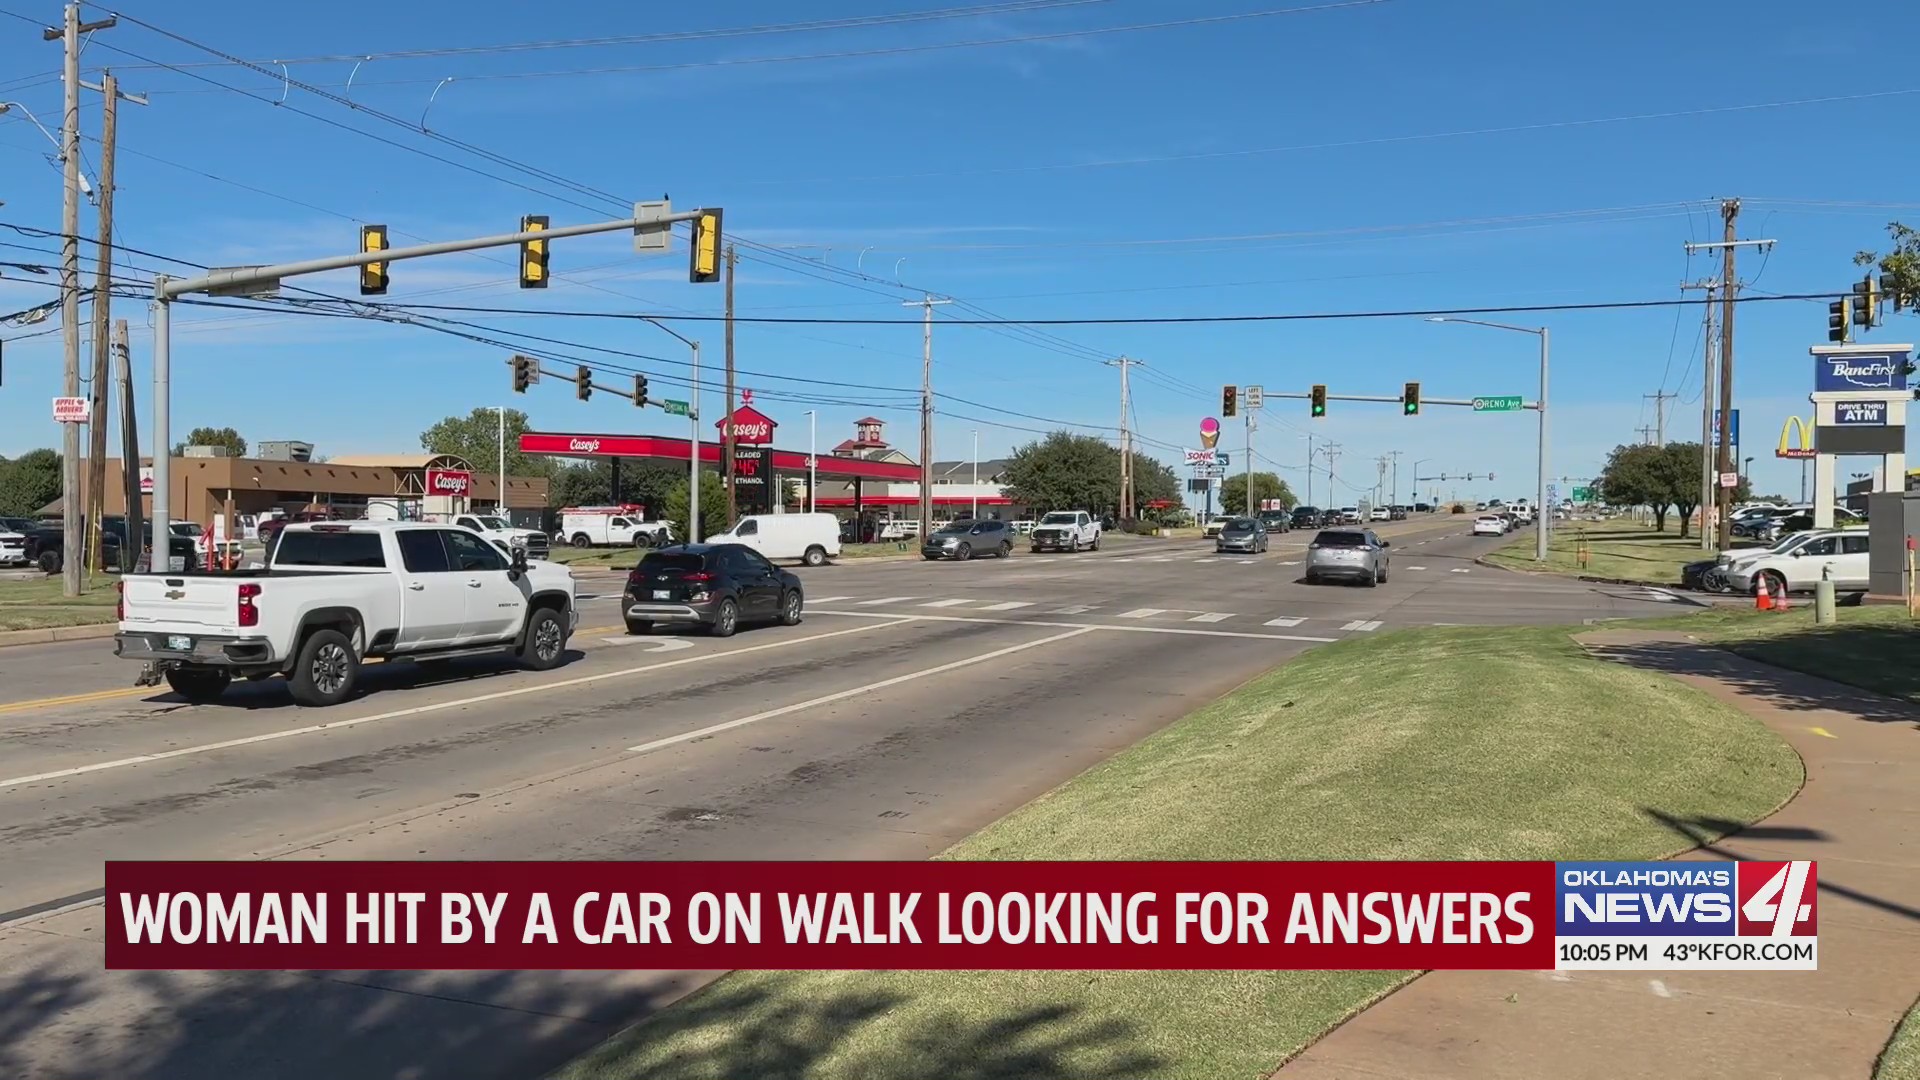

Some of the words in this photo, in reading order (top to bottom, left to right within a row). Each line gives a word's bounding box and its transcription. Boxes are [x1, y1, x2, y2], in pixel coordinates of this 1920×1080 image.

[1833, 364, 1896, 376] BancFirst
[1484, 400, 1505, 408] RENO
[1844, 410, 1878, 421] ATM
[569, 438, 600, 453] Casey's
[1187, 452, 1214, 460] SONIC
[434, 472, 467, 492] Casey's
[735, 477, 764, 485] ETHANOL
